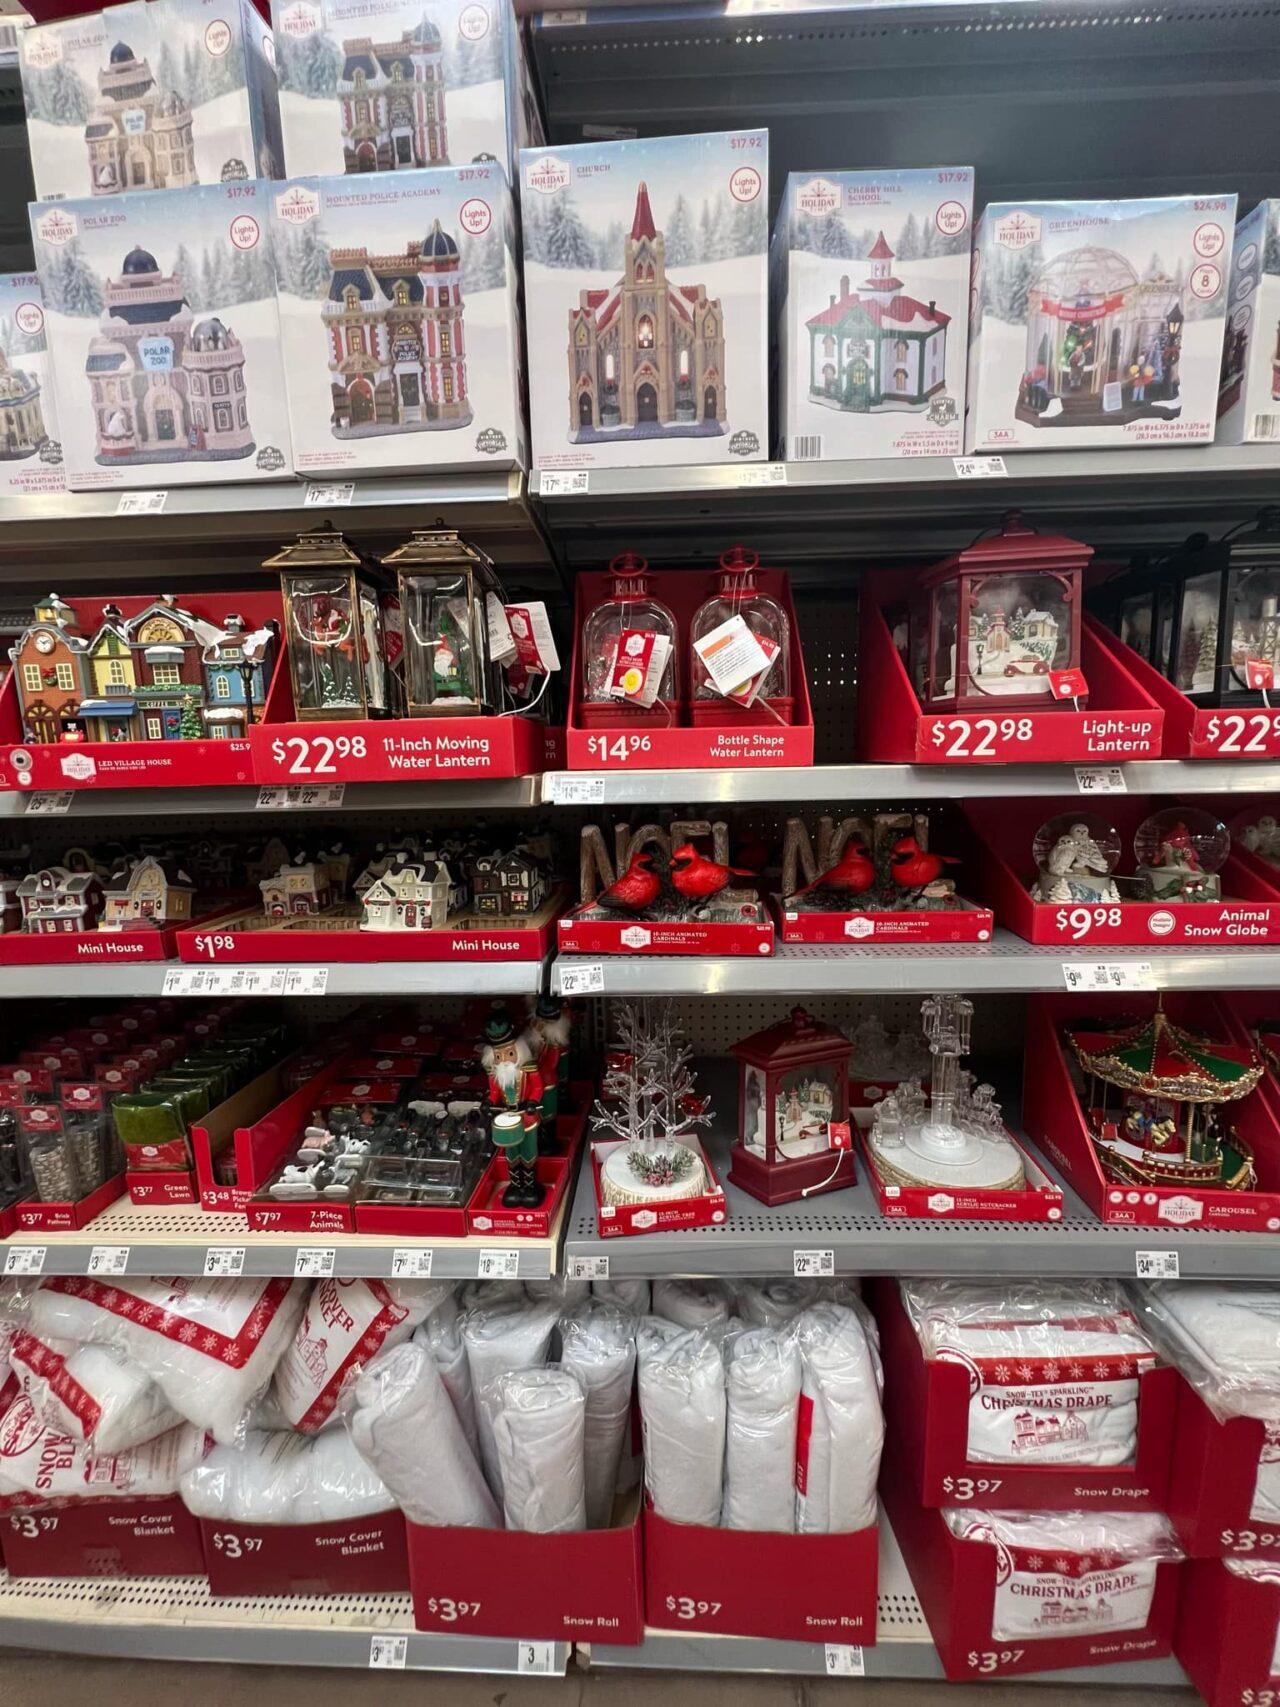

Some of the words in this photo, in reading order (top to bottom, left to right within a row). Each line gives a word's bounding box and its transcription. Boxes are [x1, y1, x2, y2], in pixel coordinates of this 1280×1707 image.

[731, 138, 762, 150] $17.92
[577, 164, 611, 174] CHURCH
[458, 170, 490, 181] $17.92
[938, 172, 969, 183] $17.92
[531, 176, 565, 186] HOLIDAY
[735, 178, 757, 188] Lights
[228, 187, 256, 198] $17.92
[739, 187, 753, 195] Up!
[848, 186, 880, 194] CHERRY
[326, 195, 367, 203] MOUNTED
[370, 191, 399, 200] POLICE
[402, 188, 441, 198] ACADEMY
[281, 206, 315, 216] HOLIDAY
[1194, 201, 1227, 211] $24.98
[465, 210, 487, 219] Lights
[940, 212, 962, 221] Lights
[83, 216, 108, 225] POLAR
[110, 215, 127, 223] ZOO
[469, 218, 483, 227] Up!
[945, 220, 958, 228] Up!
[1049, 218, 1110, 229] GREENHOUSE
[42, 228, 73, 237] HOLIDAY
[235, 226, 255, 235] Lights
[239, 234, 251, 243] Up!
[999, 231, 1035, 241] HOLIDAY
[1198, 234, 1220, 243] Lights
[1202, 242, 1215, 250] Up!
[1201, 275, 1209, 287] 8
[20, 311, 39, 320] Lights
[144, 346, 170, 357] POLAR
[151, 356, 167, 365] ZOO
[1082, 720, 1152, 735] Light-up
[383, 737, 431, 752] 11-Inch
[436, 736, 489, 753] Moving
[718, 735, 750, 745] Bottle
[753, 735, 785, 748] Shape
[1088, 738, 1150, 752] Lantern
[230, 743, 251, 751] $25.9
[710, 748, 742, 758] Water
[744, 747, 784, 757] Lantern
[114, 759, 145, 767] VILLAGE
[388, 756, 431, 769] Water
[436, 755, 491, 768] Lantern
[1219, 909, 1270, 921] Animal
[1184, 924, 1222, 936] Snow
[1226, 923, 1269, 936] Globe
[78, 943, 103, 955] Mini
[107, 941, 144, 953] House
[452, 940, 478, 950] Mini
[482, 940, 520, 951] House
[164, 1184, 189, 1193] Green
[169, 1191, 190, 1200] Lawn
[1165, 1209, 1196, 1217] HOLIDAY
[1209, 1206, 1257, 1215] CAROUSEL
[311, 1211, 342, 1221] 7-Piece
[310, 1220, 344, 1229] Animals
[981, 1394, 1063, 1411] CHRISTMAS
[1066, 1394, 1113, 1409] DRAPE
[35, 1432, 61, 1489] SNOW
[1074, 1487, 1108, 1498] Snow
[1111, 1486, 1150, 1500] Drape
[108, 1516, 137, 1525] Snow
[141, 1515, 173, 1524] Cover
[134, 1526, 175, 1536] Blanket
[315, 1536, 346, 1546] Snow
[349, 1530, 383, 1542] Cover
[341, 1542, 385, 1556] Blanket
[1010, 1583, 1092, 1600] CHRISTMAS
[1094, 1575, 1138, 1595] DRAPE
[563, 1616, 594, 1626] Snow
[597, 1617, 619, 1627] Roll
[806, 1616, 837, 1626] Snow
[840, 1616, 863, 1626] Roll
[1089, 1645, 1120, 1655] Snow
[1122, 1639, 1157, 1651] Drape
